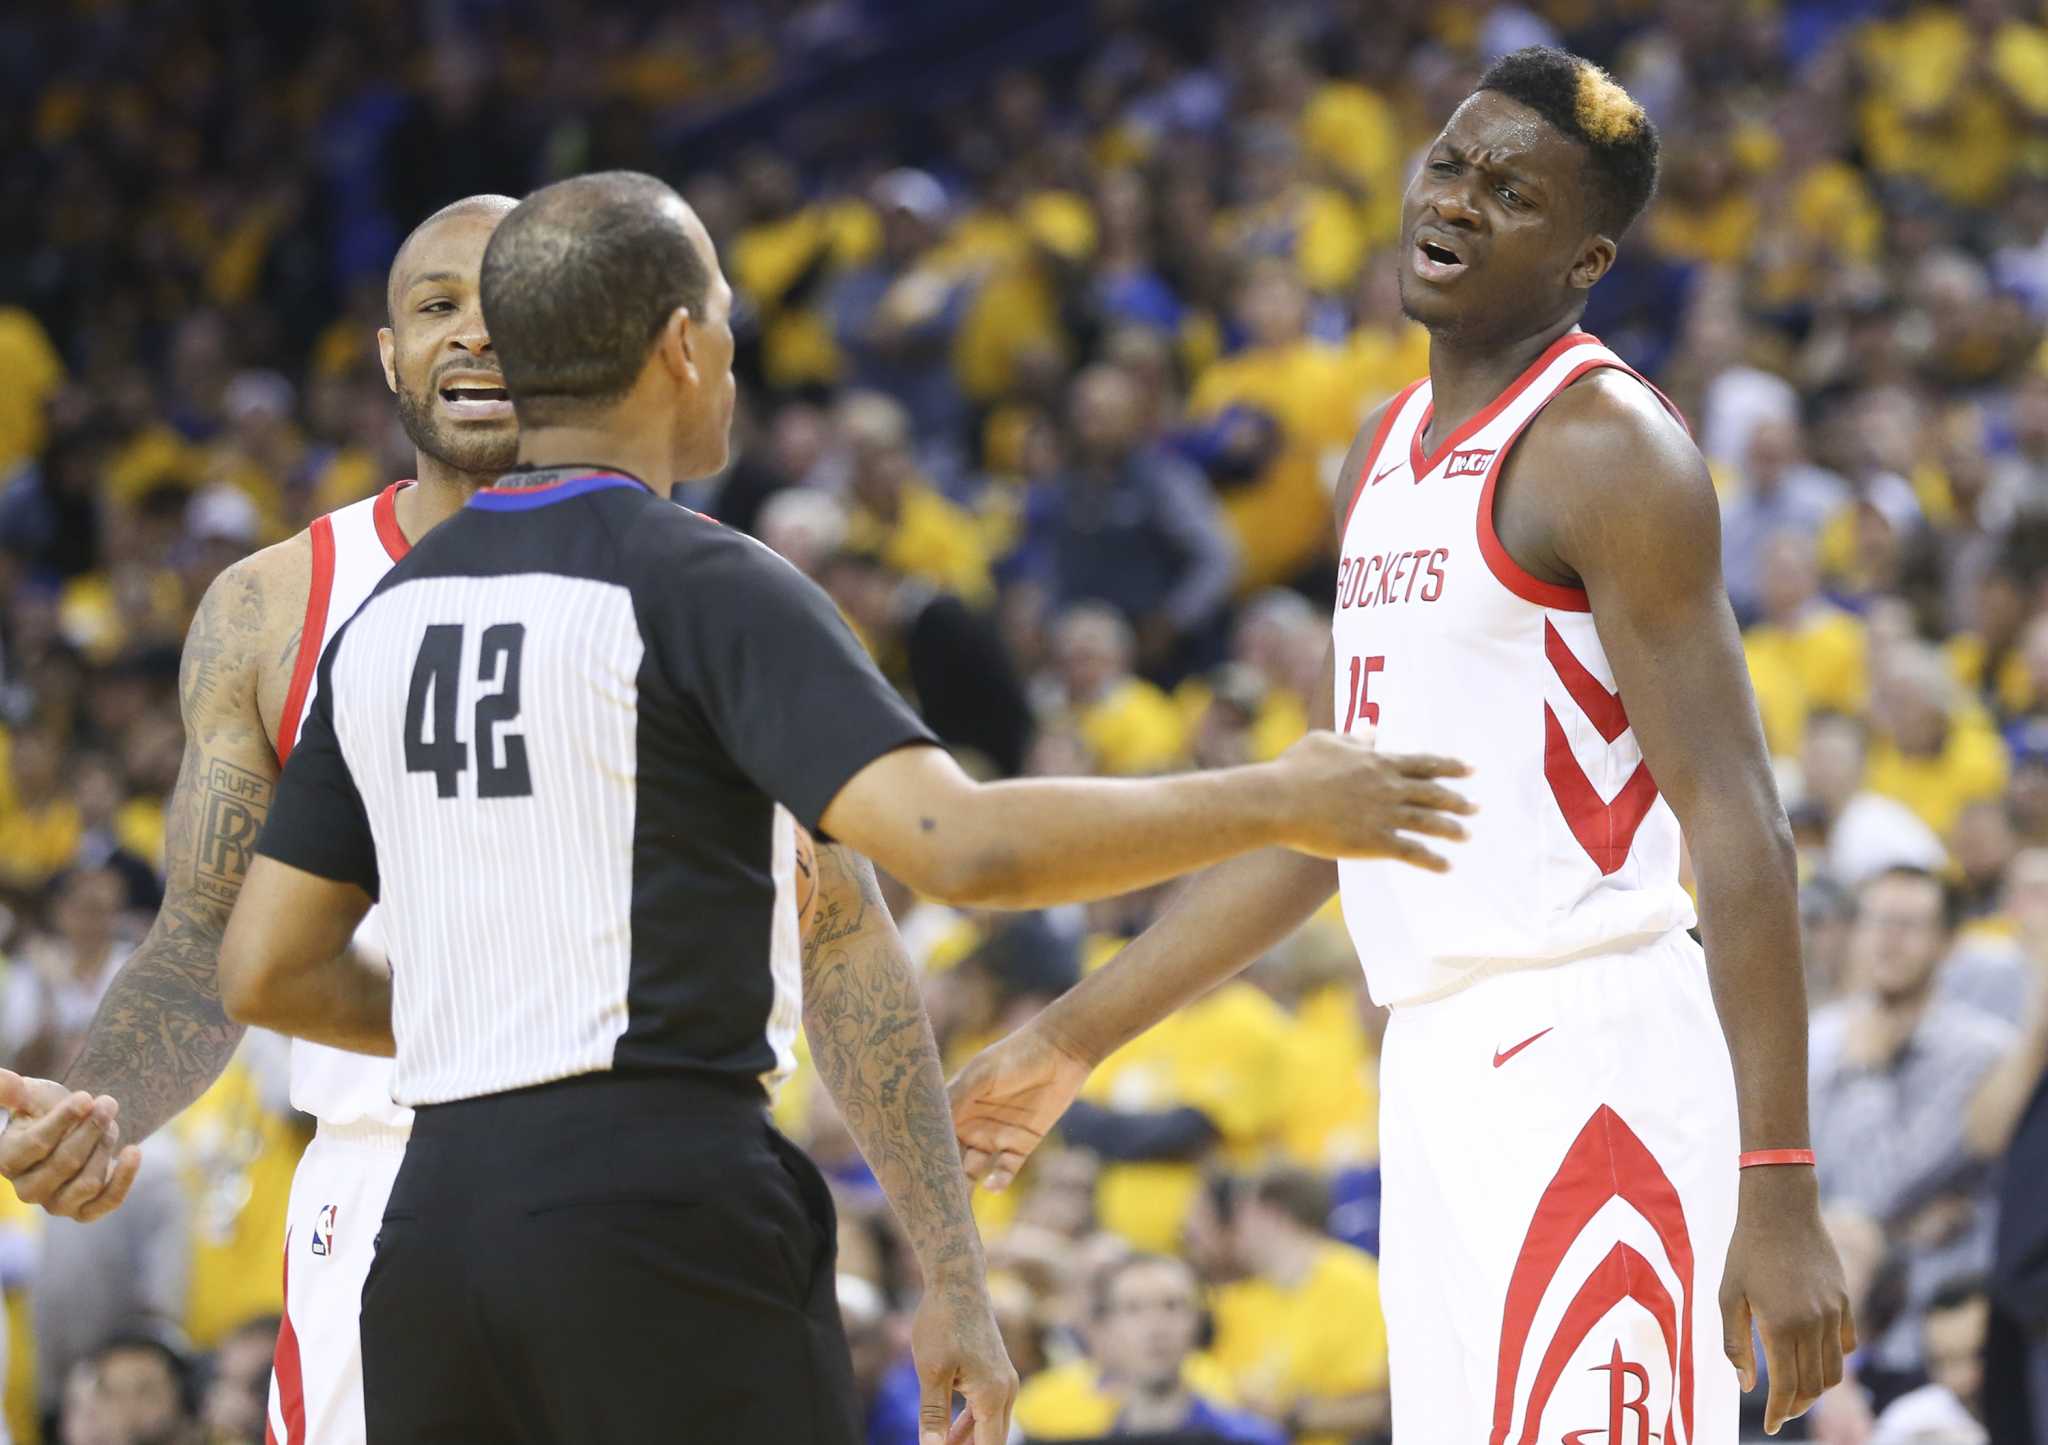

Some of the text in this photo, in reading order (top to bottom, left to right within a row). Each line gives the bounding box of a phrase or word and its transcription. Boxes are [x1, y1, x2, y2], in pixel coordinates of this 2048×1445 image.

[1336, 548, 1449, 609] ROCKETS
[404, 623, 533, 798] 42
[1343, 655, 1385, 736] 15
[214, 767, 264, 799] RUFF
